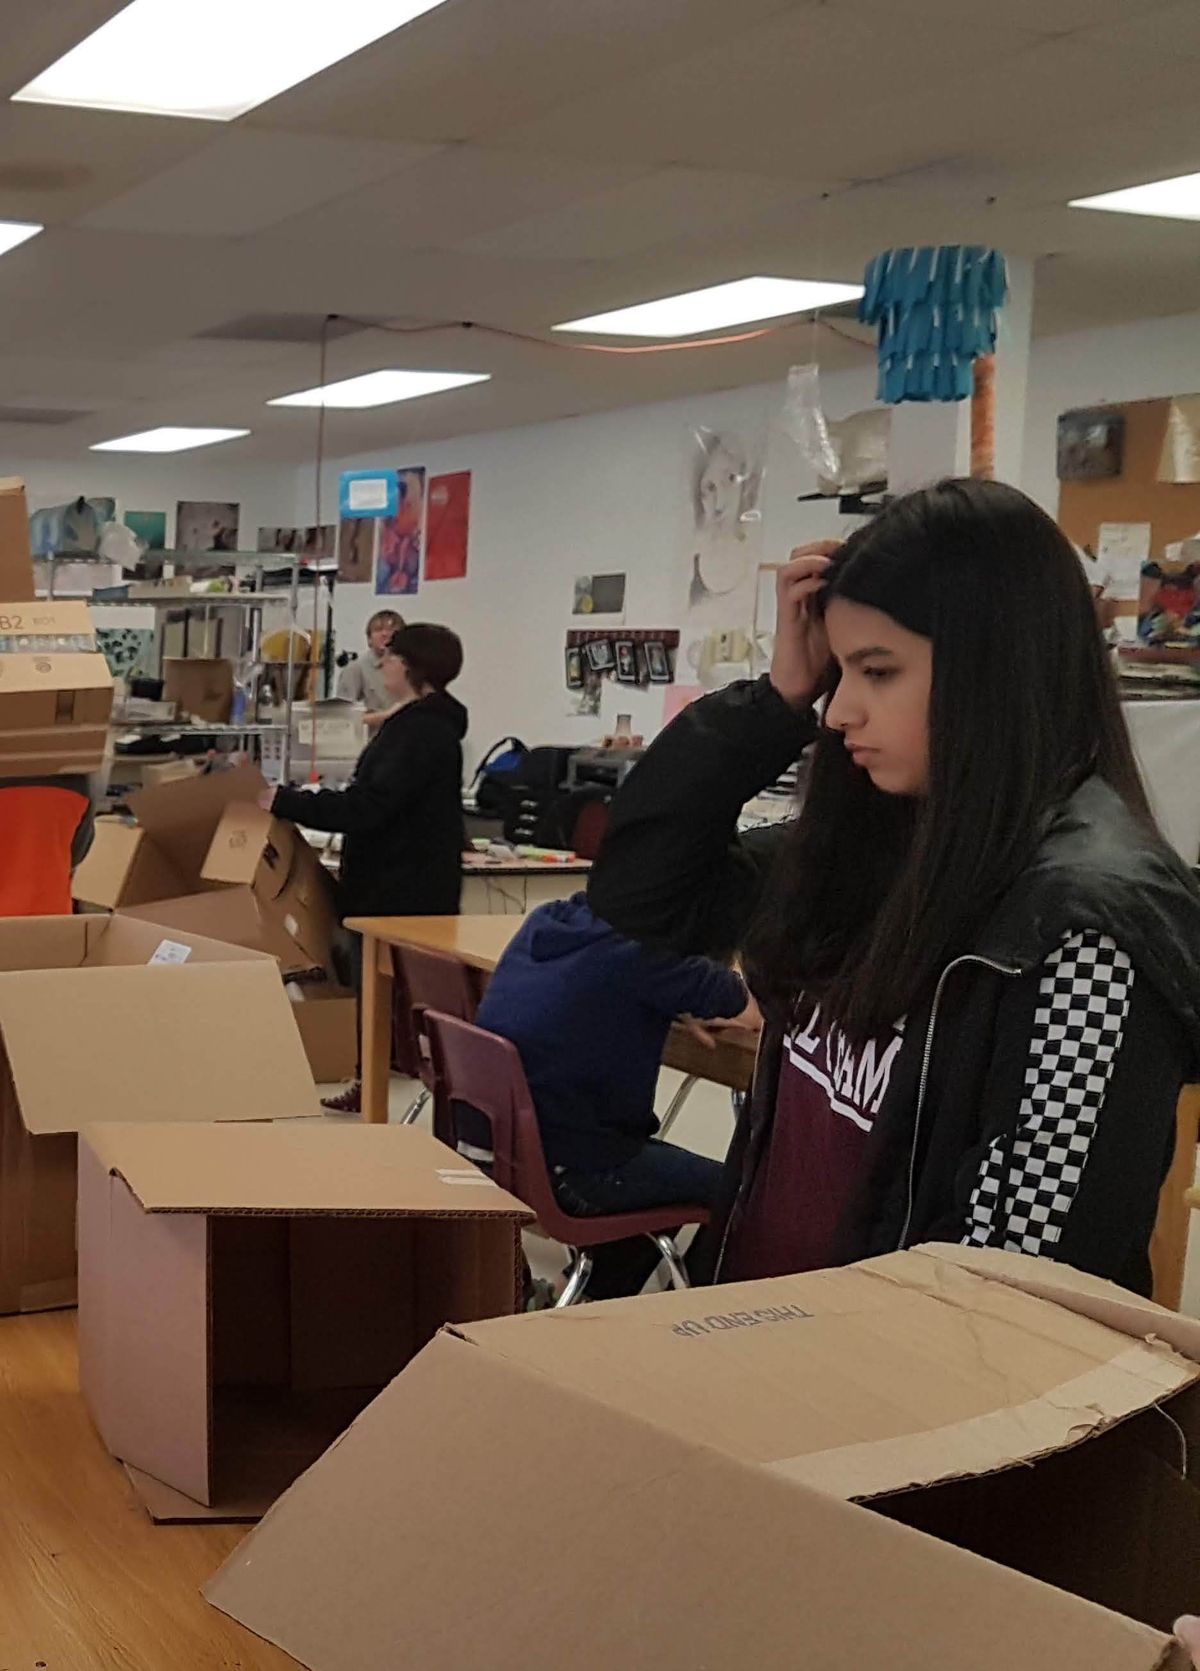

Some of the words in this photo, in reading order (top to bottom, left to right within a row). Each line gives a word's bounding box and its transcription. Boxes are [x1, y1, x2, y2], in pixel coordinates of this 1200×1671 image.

[704, 1312, 762, 1329] END
[754, 1304, 815, 1322] THIS
[672, 1319, 710, 1336] UP
